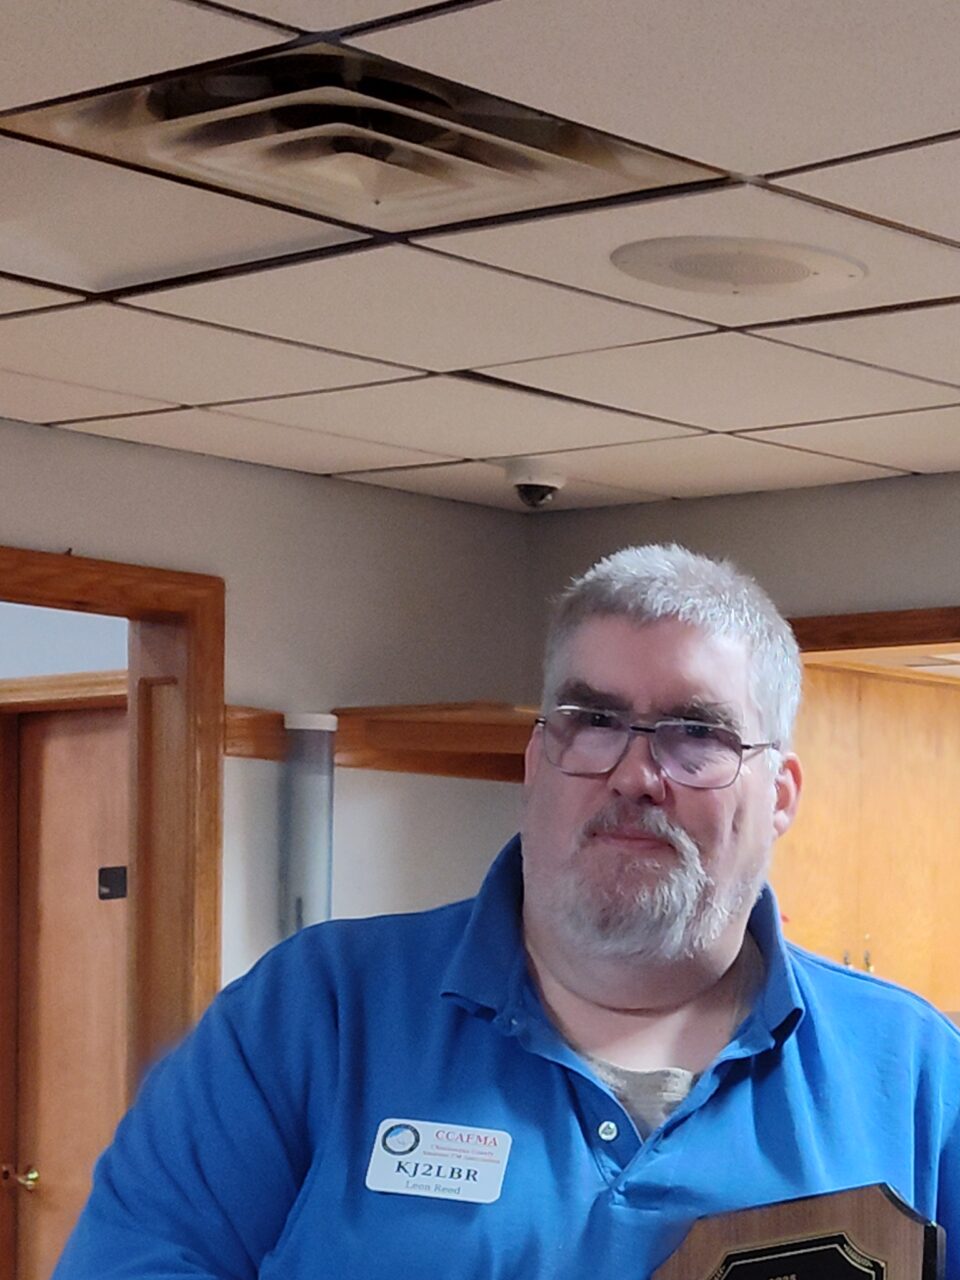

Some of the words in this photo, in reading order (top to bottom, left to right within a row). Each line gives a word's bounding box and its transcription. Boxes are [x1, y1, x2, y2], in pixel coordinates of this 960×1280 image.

[435, 1129, 498, 1147] CCAFMA
[395, 1160, 479, 1182] KJ2LBR
[405, 1180, 431, 1192] Leon
[433, 1184, 461, 1195] Reed
